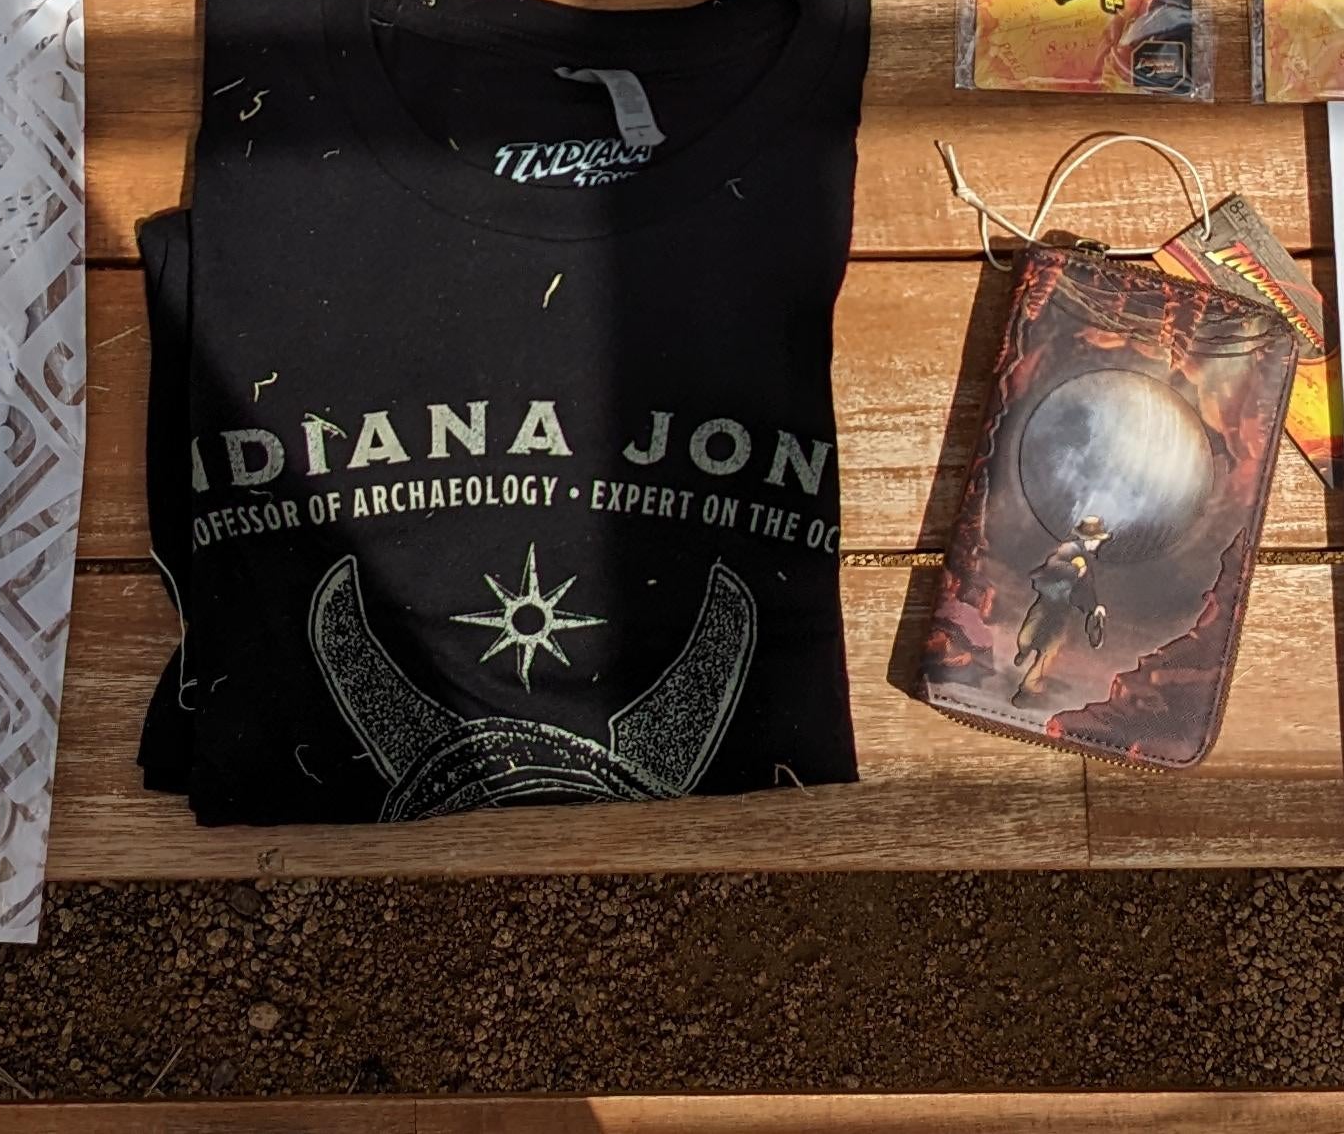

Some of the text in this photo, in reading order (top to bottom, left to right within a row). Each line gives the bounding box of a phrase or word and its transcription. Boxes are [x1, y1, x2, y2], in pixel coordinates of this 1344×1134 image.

[1229, 200, 1249, 223] 8+
[1204, 241, 1296, 315] INDIANA
[308, 491, 342, 526] OF
[353, 474, 559, 518] ARCHAEOLOGY
[590, 479, 695, 520] EXPERT
[702, 493, 740, 528] ON
[749, 502, 801, 542] THE
